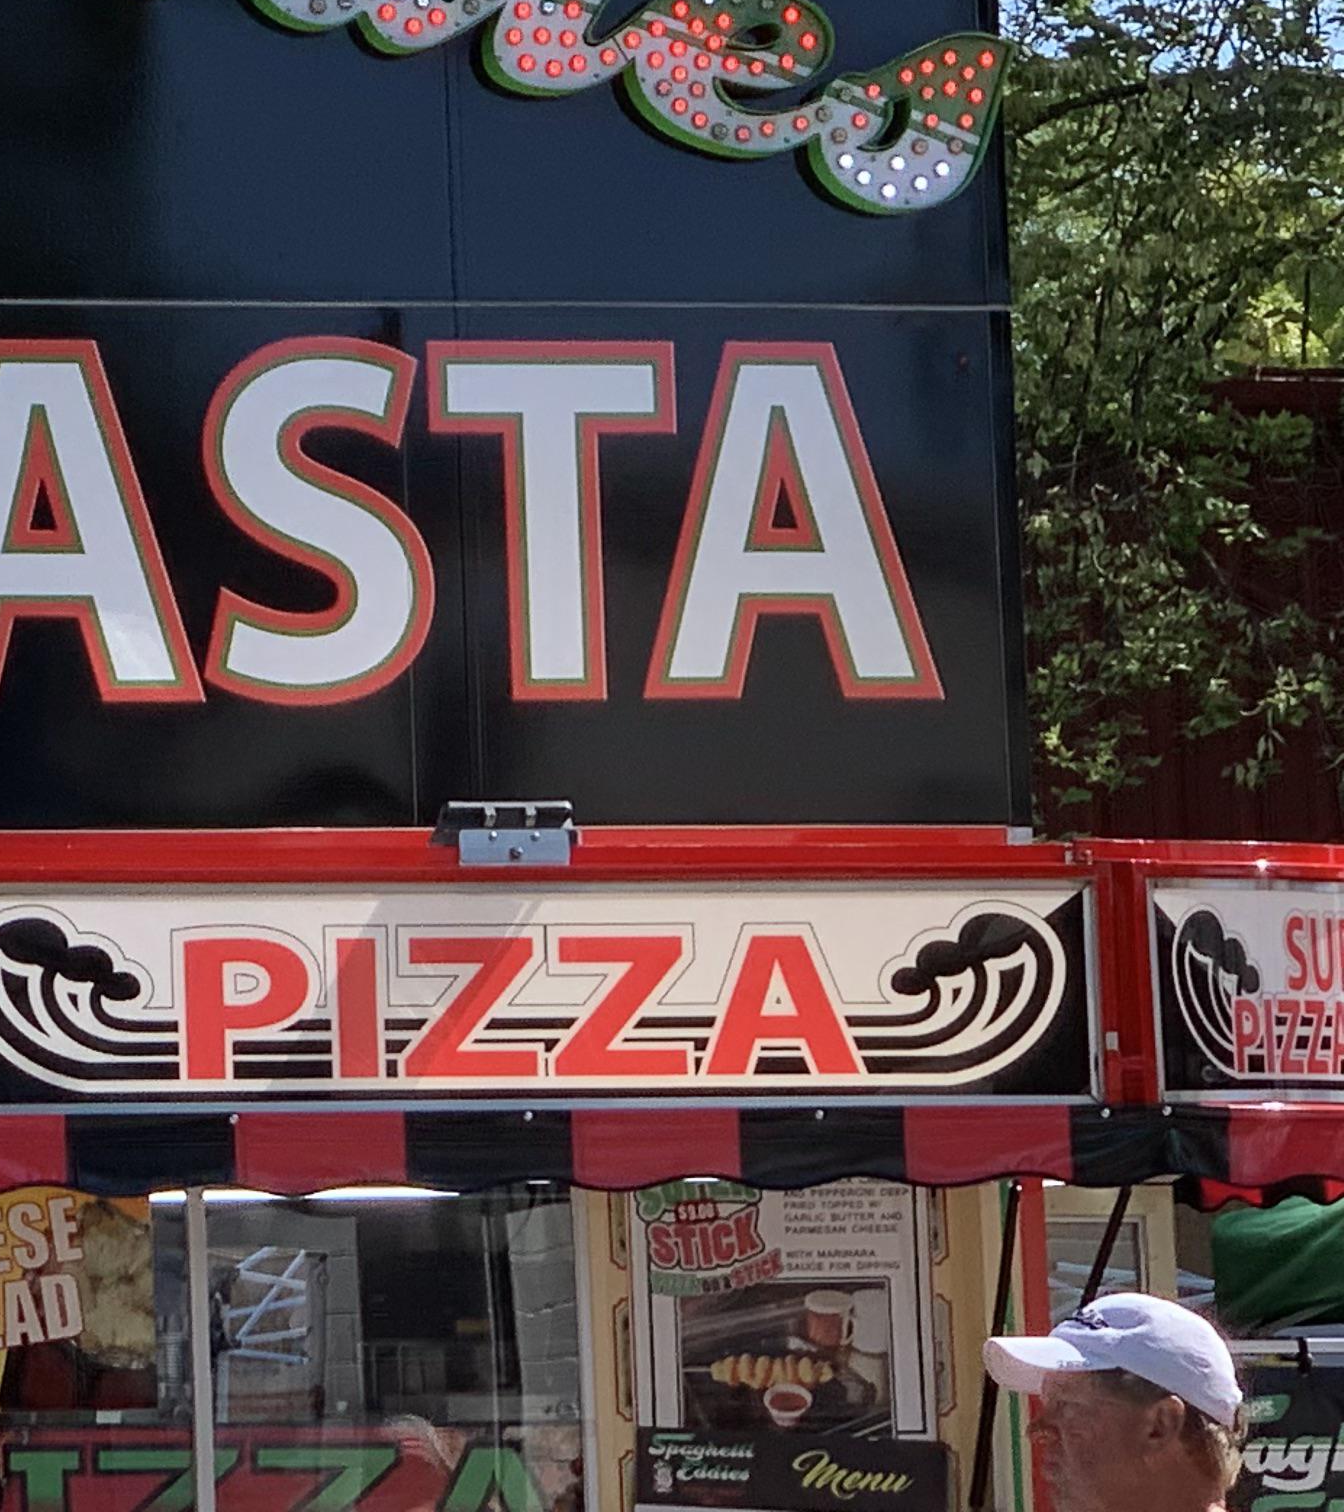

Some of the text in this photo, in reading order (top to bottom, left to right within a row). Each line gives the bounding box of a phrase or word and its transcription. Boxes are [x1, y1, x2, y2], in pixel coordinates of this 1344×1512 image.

[1286, 916, 1344, 991] SU
[182, 932, 865, 1081] PIZZA
[650, 1205, 760, 1267] STICK
[785, 1225, 847, 1234] PARMESAN
[830, 1212, 874, 1222] BUTTER
[880, 1211, 903, 1221] AND
[648, 1433, 754, 1460] Spaghetti
[675, 1459, 751, 1482] Eddies
[792, 1449, 913, 1500] Menu
